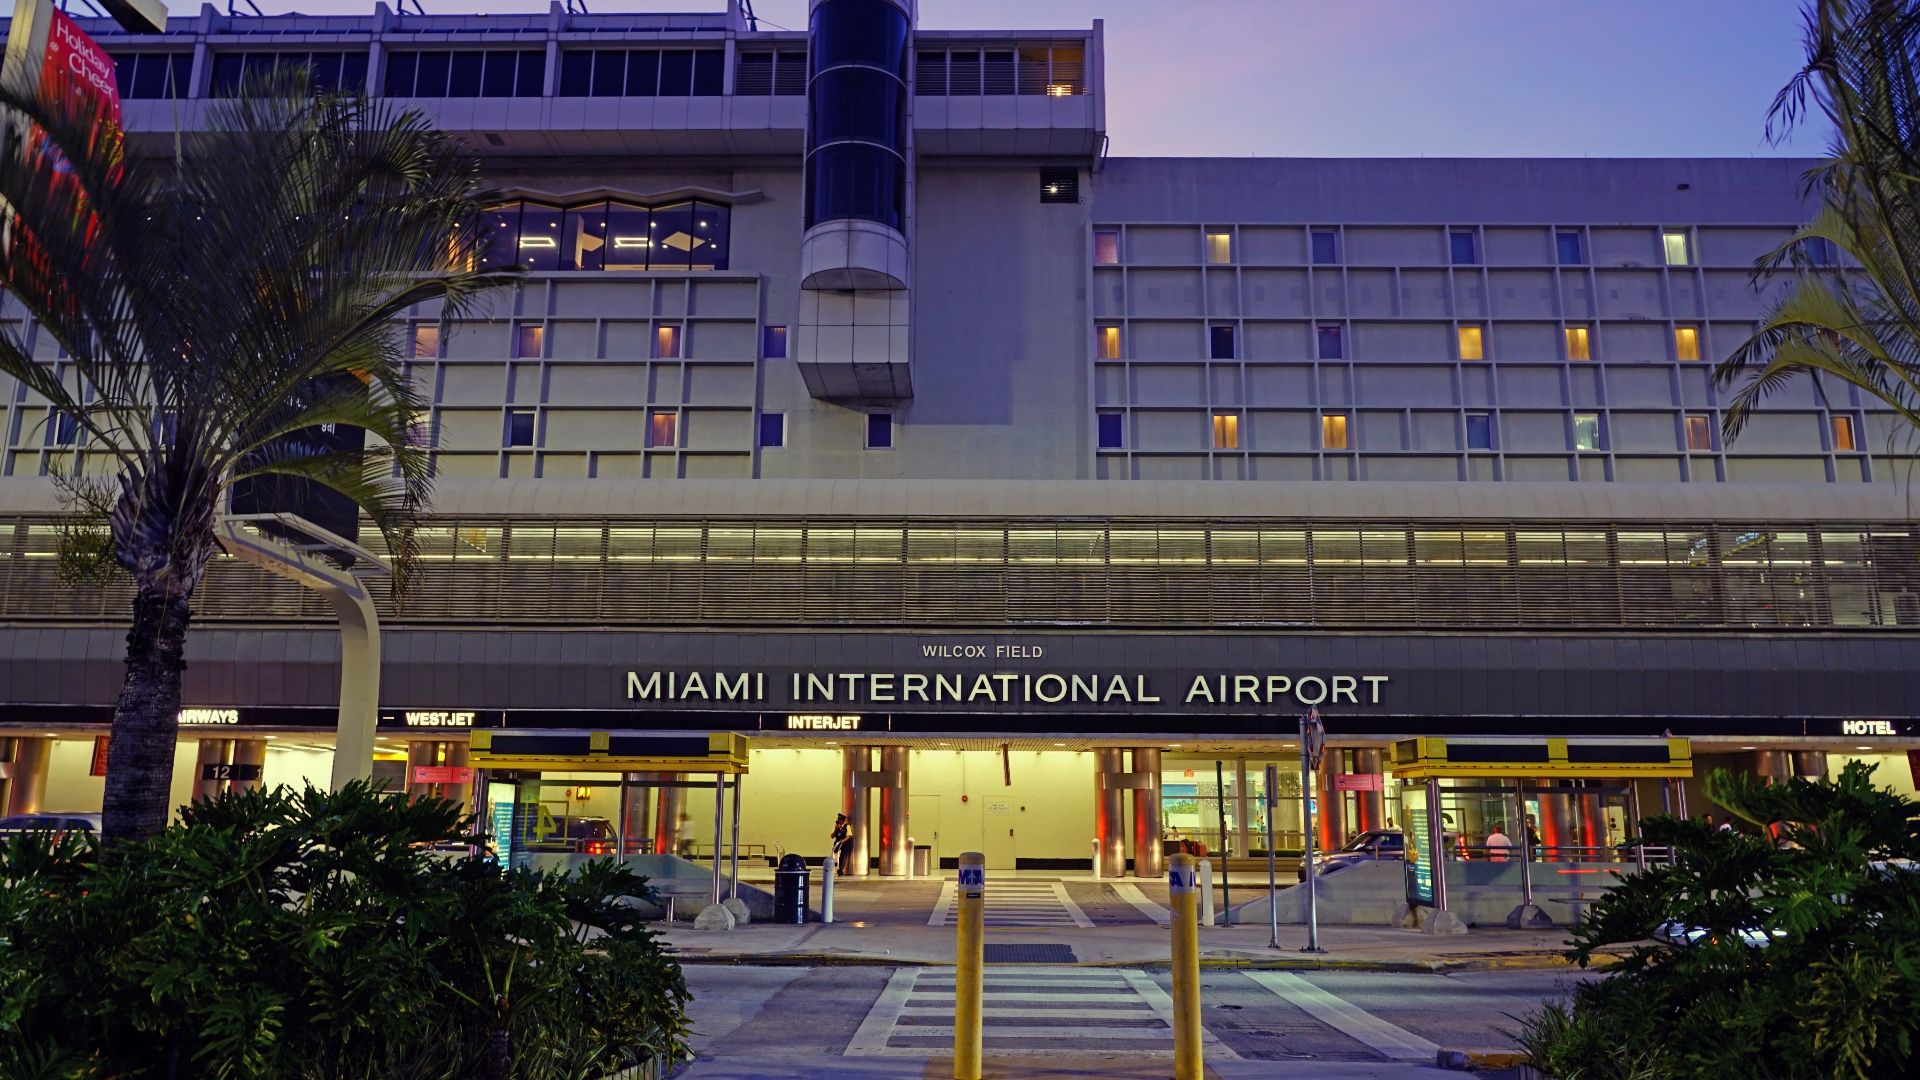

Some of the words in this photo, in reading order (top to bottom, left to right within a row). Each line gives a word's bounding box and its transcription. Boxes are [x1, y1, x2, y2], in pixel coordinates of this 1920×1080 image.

[56, 18, 110, 79] Holiday
[68, 52, 114, 97] Cheer
[922, 645, 986, 658] WILCOX
[996, 645, 1043, 658] FIELD
[627, 671, 763, 700] MIAMI
[793, 672, 1160, 703] INTERNATIONAL
[1185, 674, 1389, 705] AIRPORT
[405, 711, 476, 726] WESTJET
[787, 715, 862, 730] INTERJET
[1842, 720, 1897, 735] HOTEL
[595, 733, 604, 747] 4
[1553, 741, 1563, 756] 3
[212, 765, 231, 779] 12
